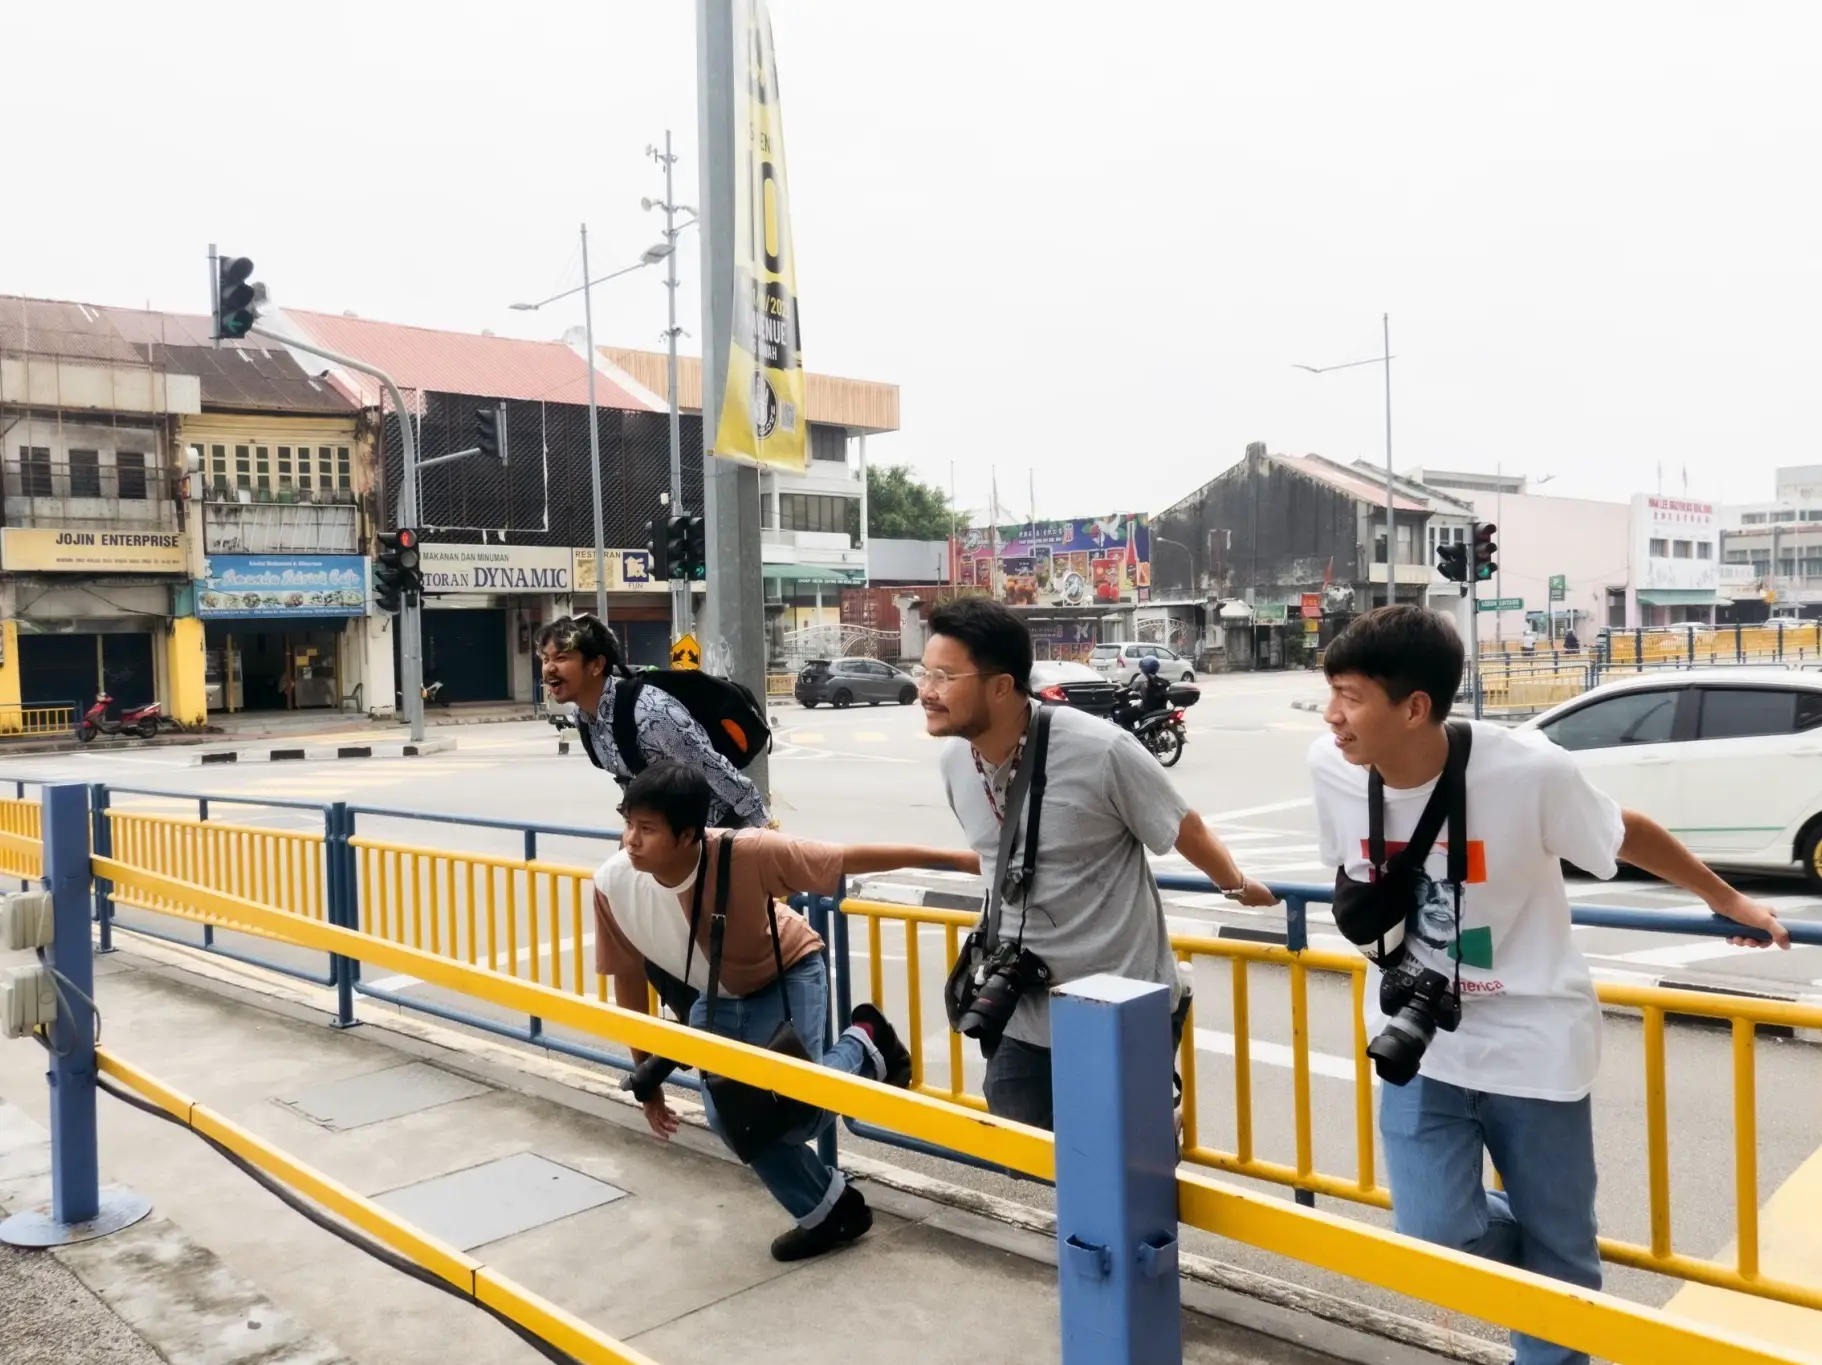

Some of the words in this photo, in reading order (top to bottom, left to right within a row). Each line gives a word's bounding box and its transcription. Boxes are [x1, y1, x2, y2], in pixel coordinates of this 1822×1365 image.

[56, 533, 95, 546] JOJIN
[101, 534, 179, 548] ENTERPRISE
[423, 552, 459, 561] MAKANAN
[461, 552, 476, 561] DAN
[477, 553, 509, 562] MINUMAN
[473, 567, 568, 588] DYNAMIC
[1452, 980, 1504, 992] merica
